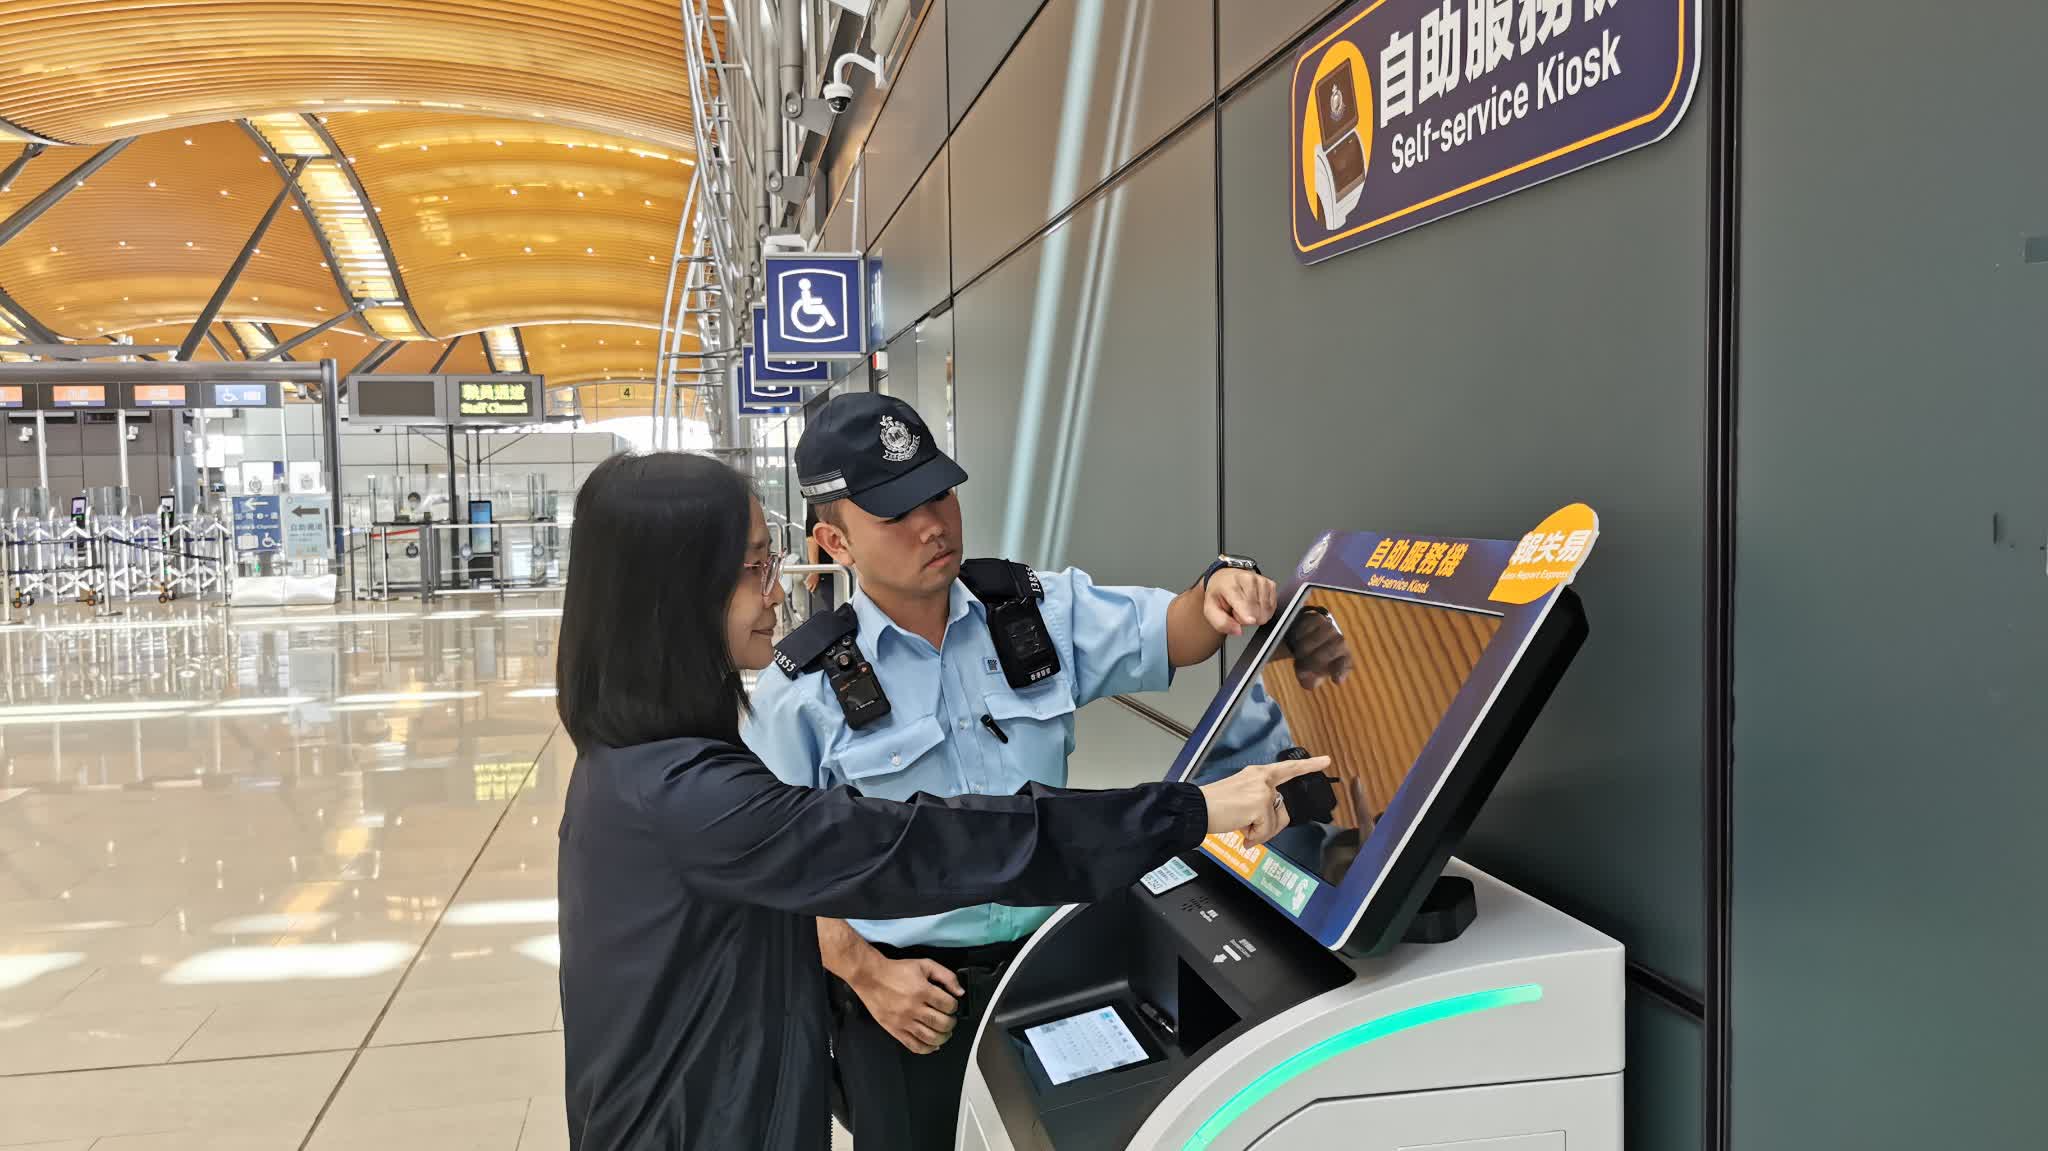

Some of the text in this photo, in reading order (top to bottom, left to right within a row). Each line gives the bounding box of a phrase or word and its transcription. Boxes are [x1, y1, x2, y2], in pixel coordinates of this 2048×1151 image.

[1380, 0, 1618, 128] 自助服務
[1391, 29, 1622, 174] Self-service Kiosk
[623, 387, 631, 398] 4
[1365, 537, 1469, 577] 自助服務機
[1509, 529, 1593, 565] 報失易
[1367, 574, 1430, 594] Self-service Kiosk
